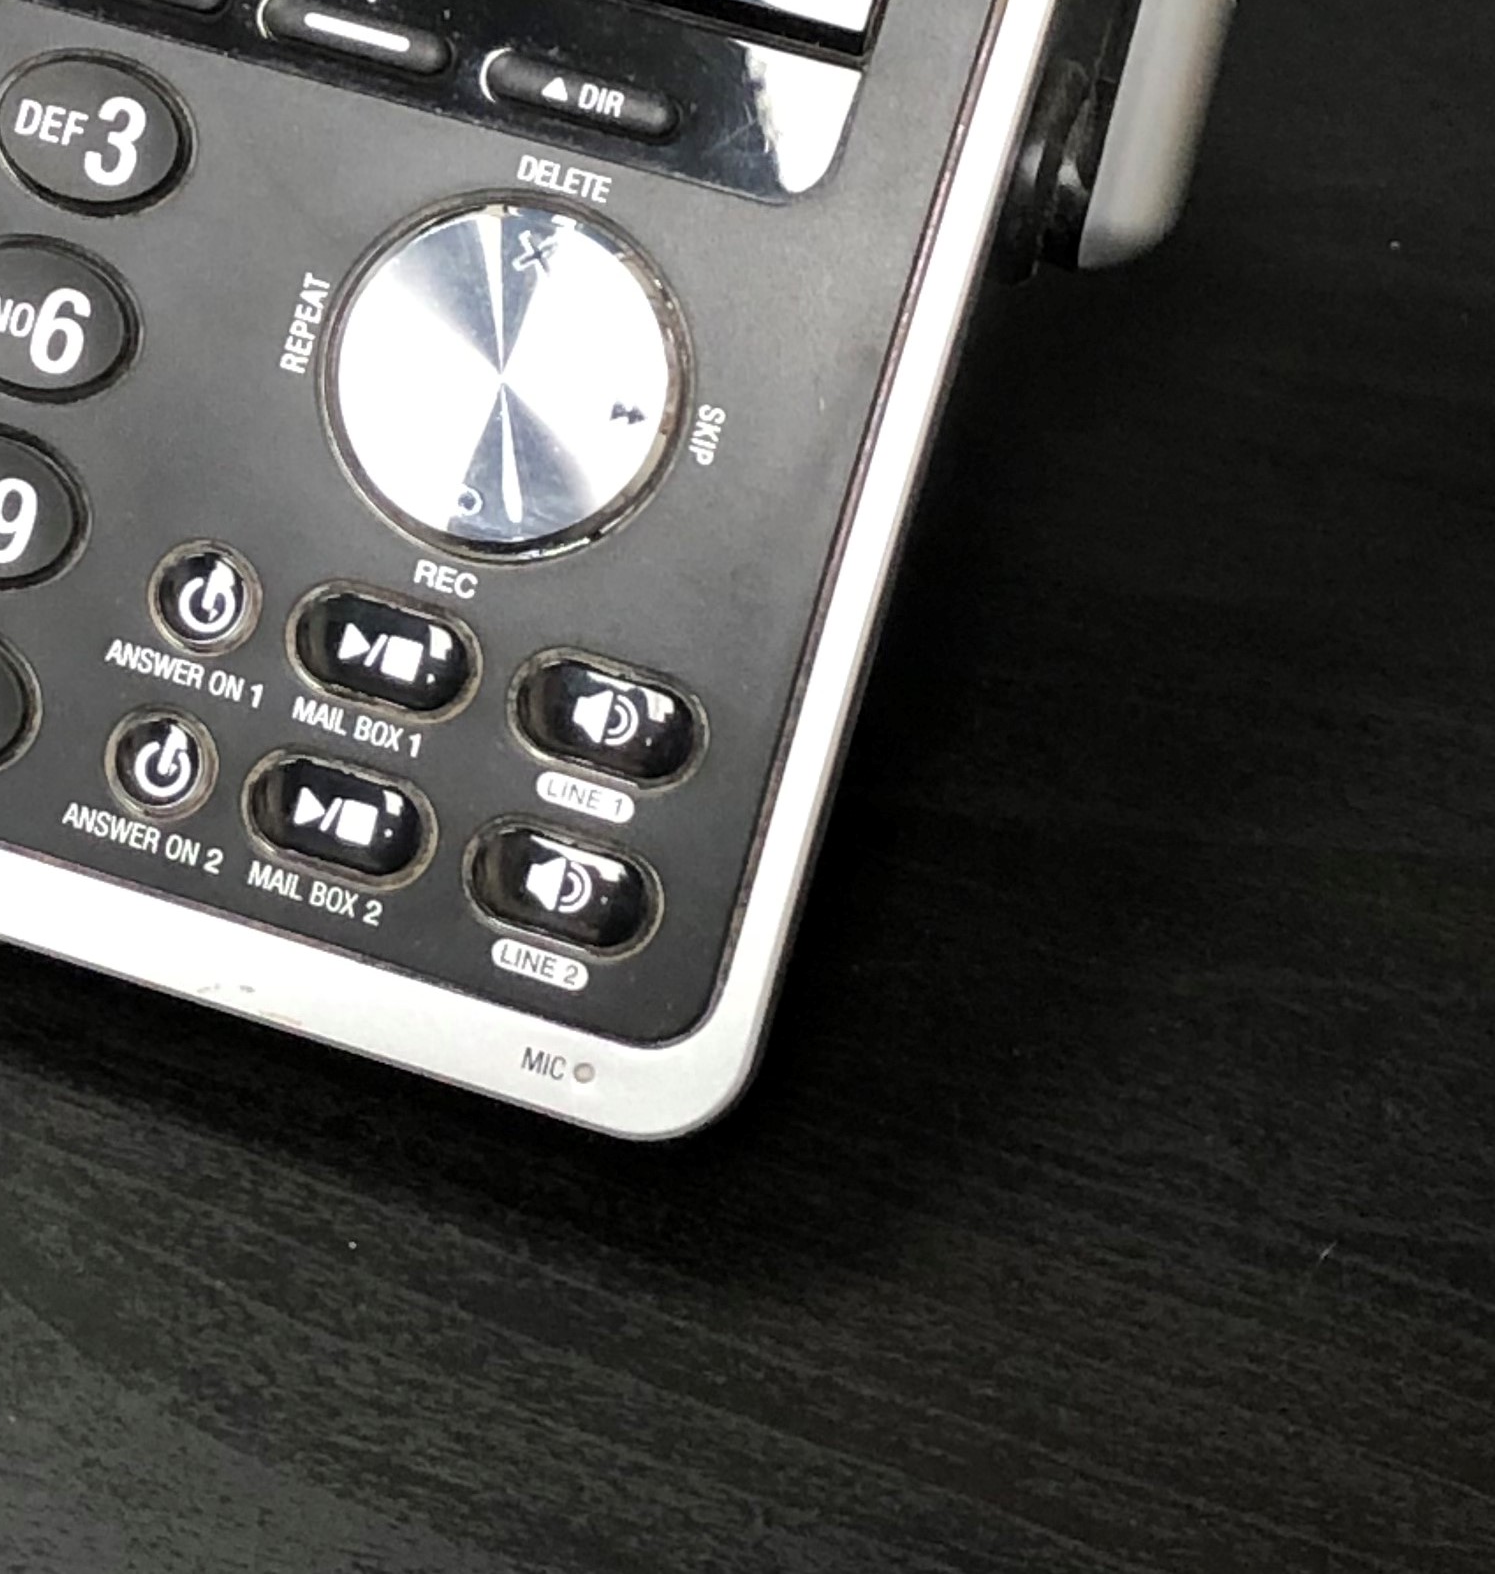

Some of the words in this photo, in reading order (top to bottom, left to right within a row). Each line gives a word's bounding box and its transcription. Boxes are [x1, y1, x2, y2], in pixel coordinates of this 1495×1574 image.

[577, 82, 626, 117] DIR
[83, 95, 147, 187] 3
[517, 154, 612, 204] DELETE
[28, 287, 91, 375] 6
[279, 272, 331, 375] REPEAT
[688, 403, 726, 467] SKIP
[414, 559, 479, 600] REC
[105, 639, 202, 691] ANSWER
[208, 668, 246, 703] ON
[249, 683, 264, 709] 1
[292, 696, 346, 737] MAIL
[353, 718, 403, 750] BOX
[408, 733, 422, 759] 1
[546, 777, 604, 812] LINE
[612, 797, 624, 818] 1
[62, 802, 159, 854] ANSWER
[164, 832, 201, 867] ON
[205, 848, 225, 876] 2
[247, 860, 303, 902] MAIL
[309, 882, 360, 918] BOX
[362, 899, 384, 928] 2
[500, 943, 557, 979] LINE
[563, 964, 581, 986] 2
[521, 1046, 567, 1082] MIC
